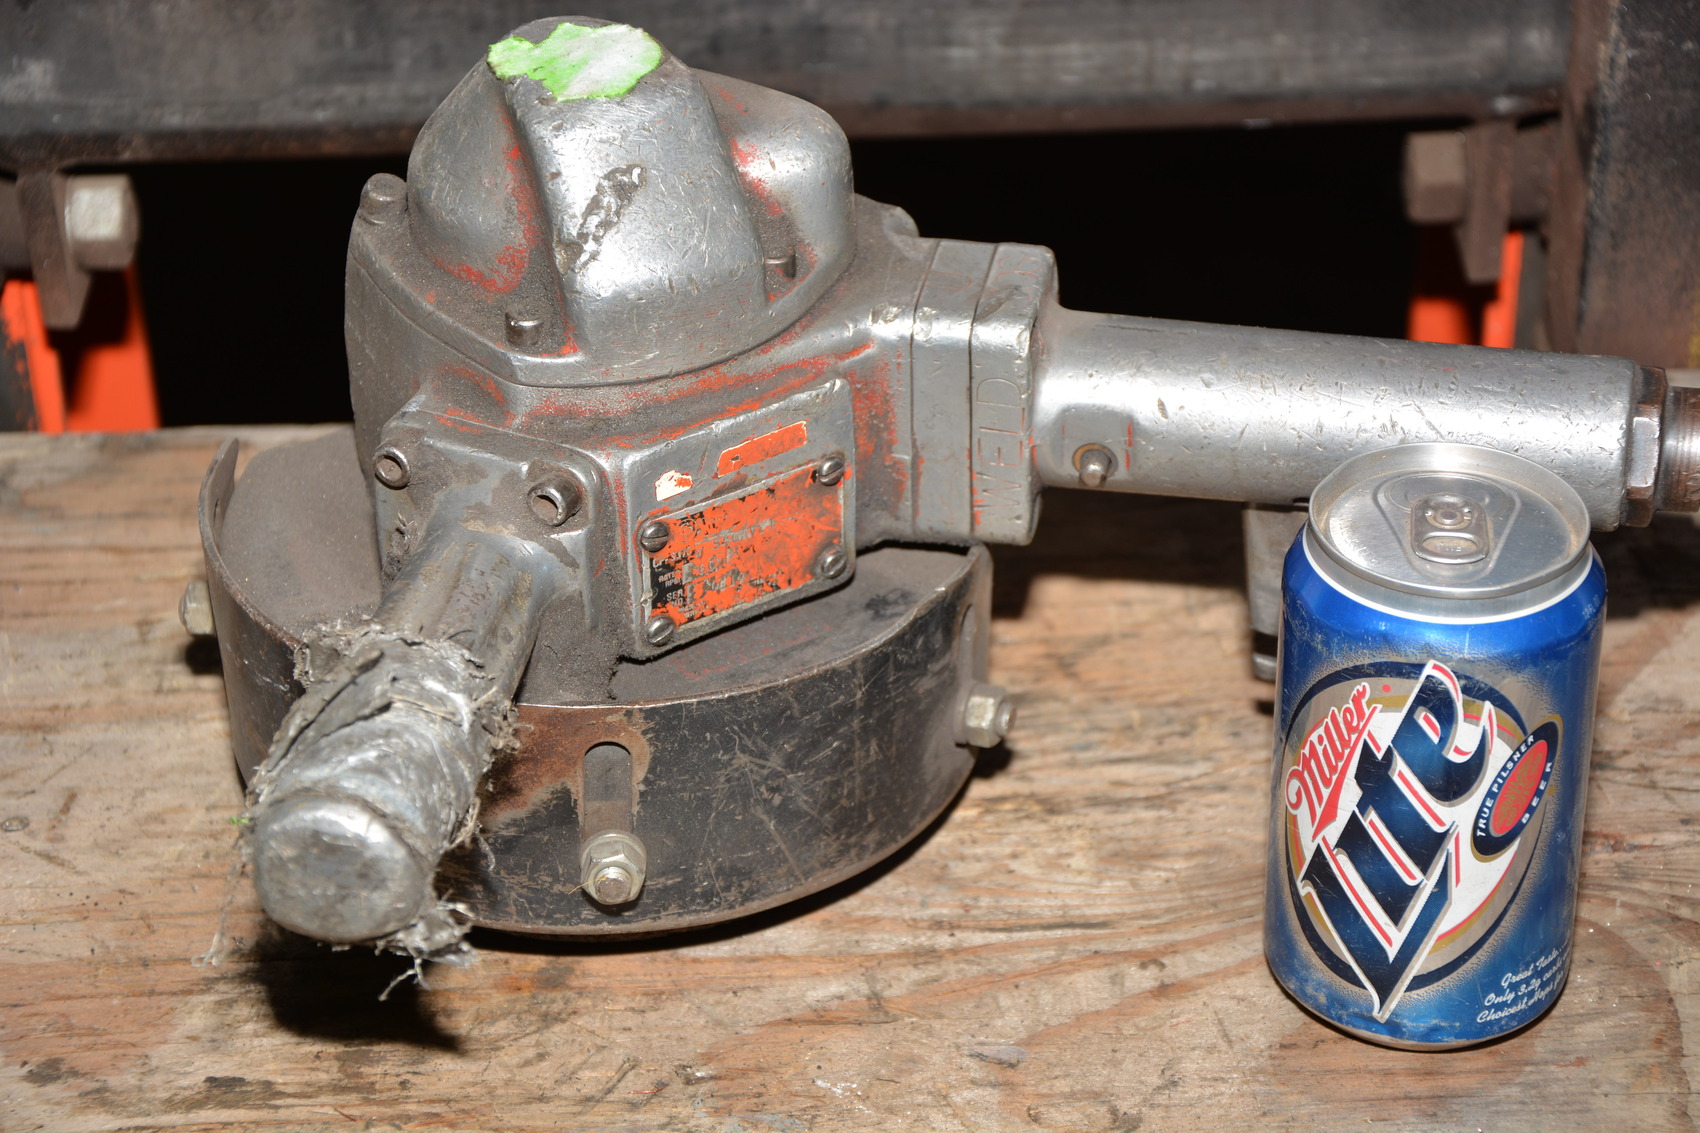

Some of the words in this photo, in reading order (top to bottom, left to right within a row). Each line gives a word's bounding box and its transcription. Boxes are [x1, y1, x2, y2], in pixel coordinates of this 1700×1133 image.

[974, 377, 1025, 508] WELD
[1285, 682, 1372, 832] Miller
[1476, 797, 1494, 837] TRUE
[1491, 734, 1535, 793] PILSNER
[1521, 762, 1553, 824] BEER
[1484, 988, 1516, 1006] Only
[1518, 978, 1542, 996] 3.2g
[1501, 963, 1535, 989] Great
[1476, 996, 1528, 1023] Choicest
